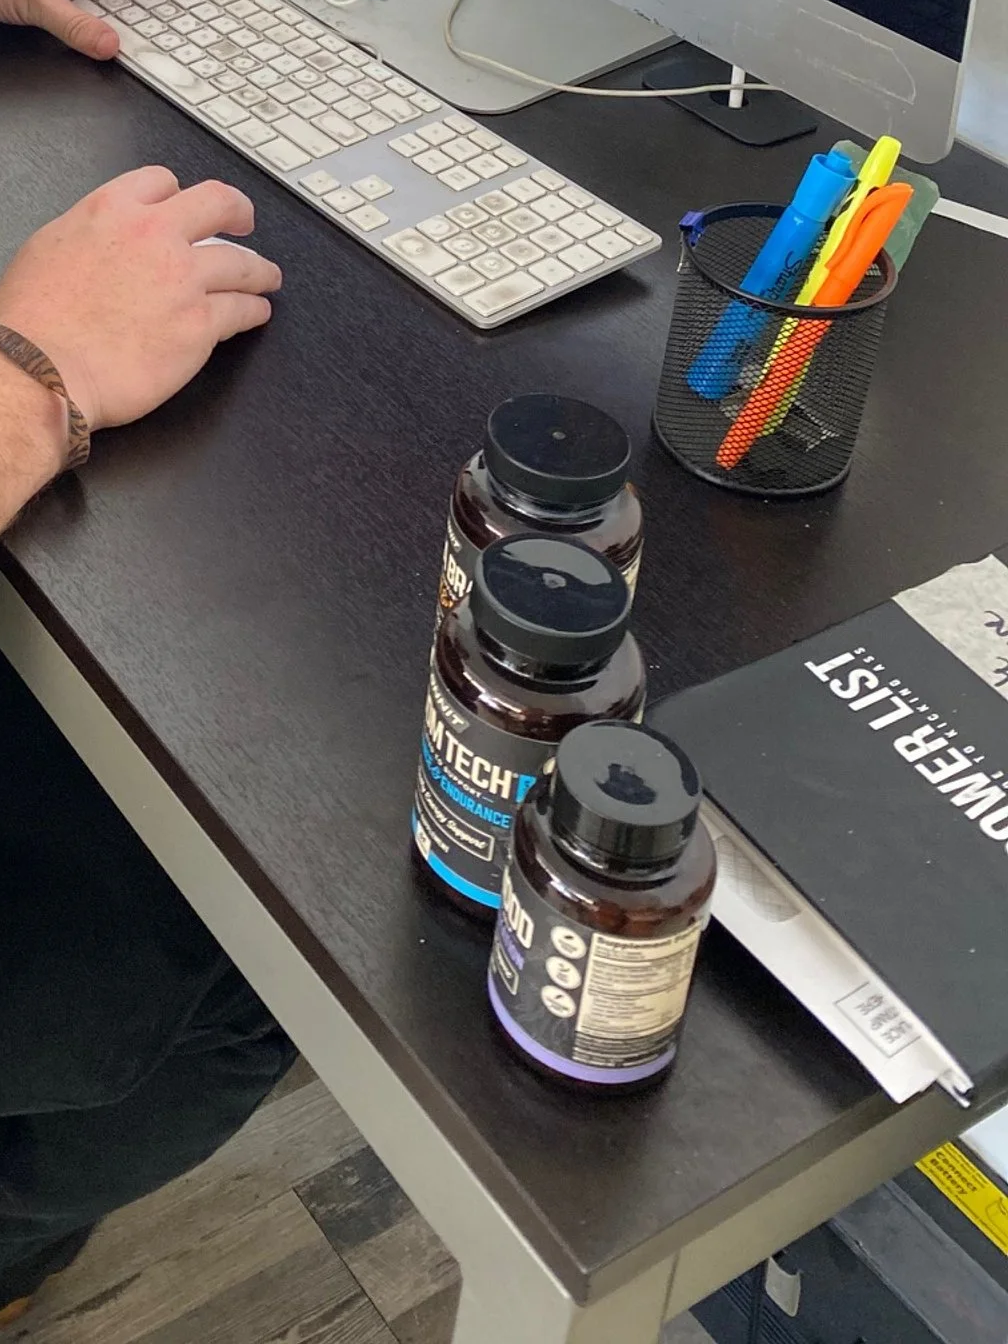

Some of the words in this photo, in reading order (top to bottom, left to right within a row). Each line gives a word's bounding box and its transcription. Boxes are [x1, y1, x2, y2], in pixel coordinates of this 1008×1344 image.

[853, 646, 886, 673] ASS
[803, 651, 915, 731] LIST
[888, 678, 959, 740] KICKING
[962, 745, 986, 764] TO
[439, 775, 512, 829] ENDURANCE
[893, 723, 1008, 856] OWER
[596, 936, 673, 950] Supplement
[929, 1157, 969, 1196] Battery
[935, 1151, 977, 1193] Connect
